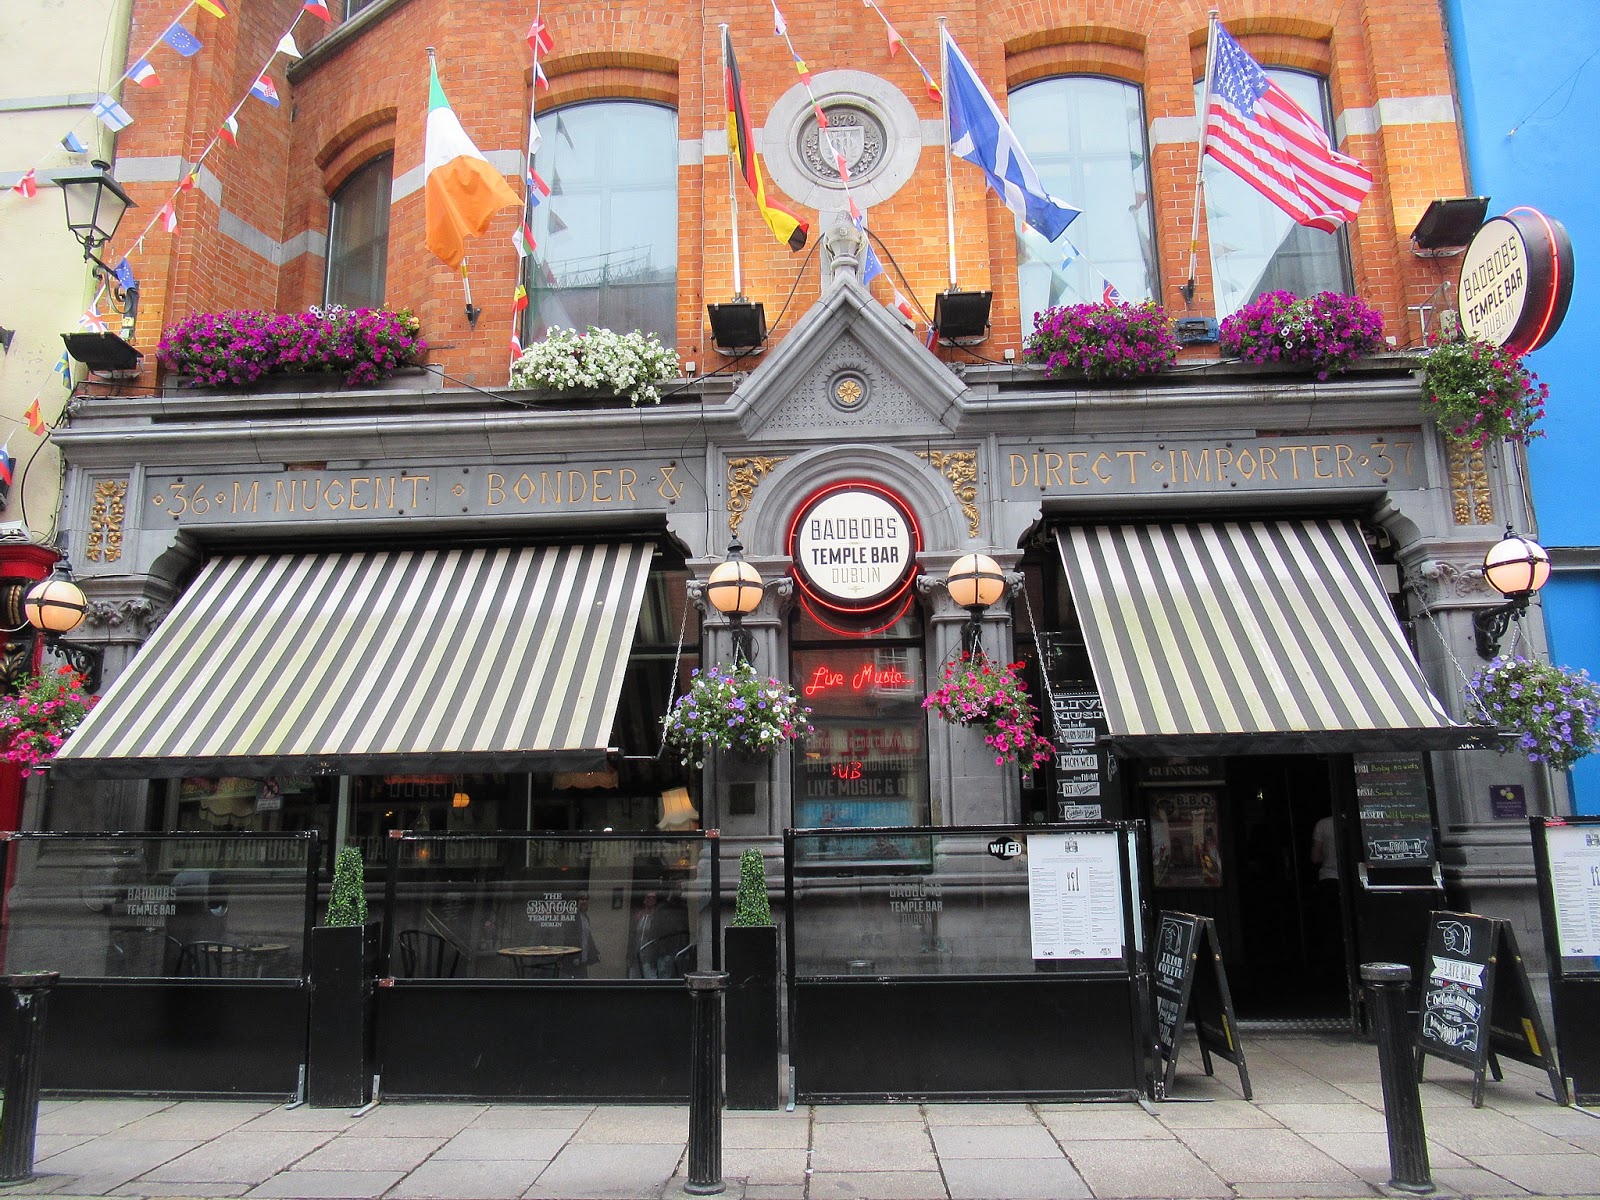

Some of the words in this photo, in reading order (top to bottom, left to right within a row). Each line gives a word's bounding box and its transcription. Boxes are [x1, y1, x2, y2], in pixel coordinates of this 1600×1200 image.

[1463, 235, 1518, 302] BADBOBS
[1468, 284, 1505, 327] TEMPLE
[1504, 267, 1524, 299] BAR
[1483, 301, 1516, 339] DUBLIN
[1009, 450, 1147, 487] DIRECT
[1168, 444, 1356, 483] IMPORTER
[231, 480, 260, 513] M
[274, 475, 431, 513] NUGENT
[487, 467, 639, 506] BONDER
[656, 466, 684, 500] &
[811, 517, 898, 541] BADBOBS
[812, 547, 867, 565] TEMPLE
[871, 546, 899, 564] BAR
[832, 567, 881, 584] DUBLIN
[805, 667, 844, 695] Live
[1054, 711, 1105, 720] MUSI
[1149, 765, 1209, 776] GUINNESS
[807, 779, 835, 796] LIVE
[838, 778, 882, 796] MUSIC
[127, 887, 177, 900] BADBOBS
[127, 905, 158, 916] TEMPLE
[160, 904, 176, 916] BAR
[527, 900, 578, 915] SNUG
[890, 901, 924, 912] TEMPLE
[925, 901, 943, 912] BAR
[902, 913, 932, 923] DUBLIN
[1161, 952, 1183, 968] IRISH
[1158, 962, 1184, 979] COFFEE
